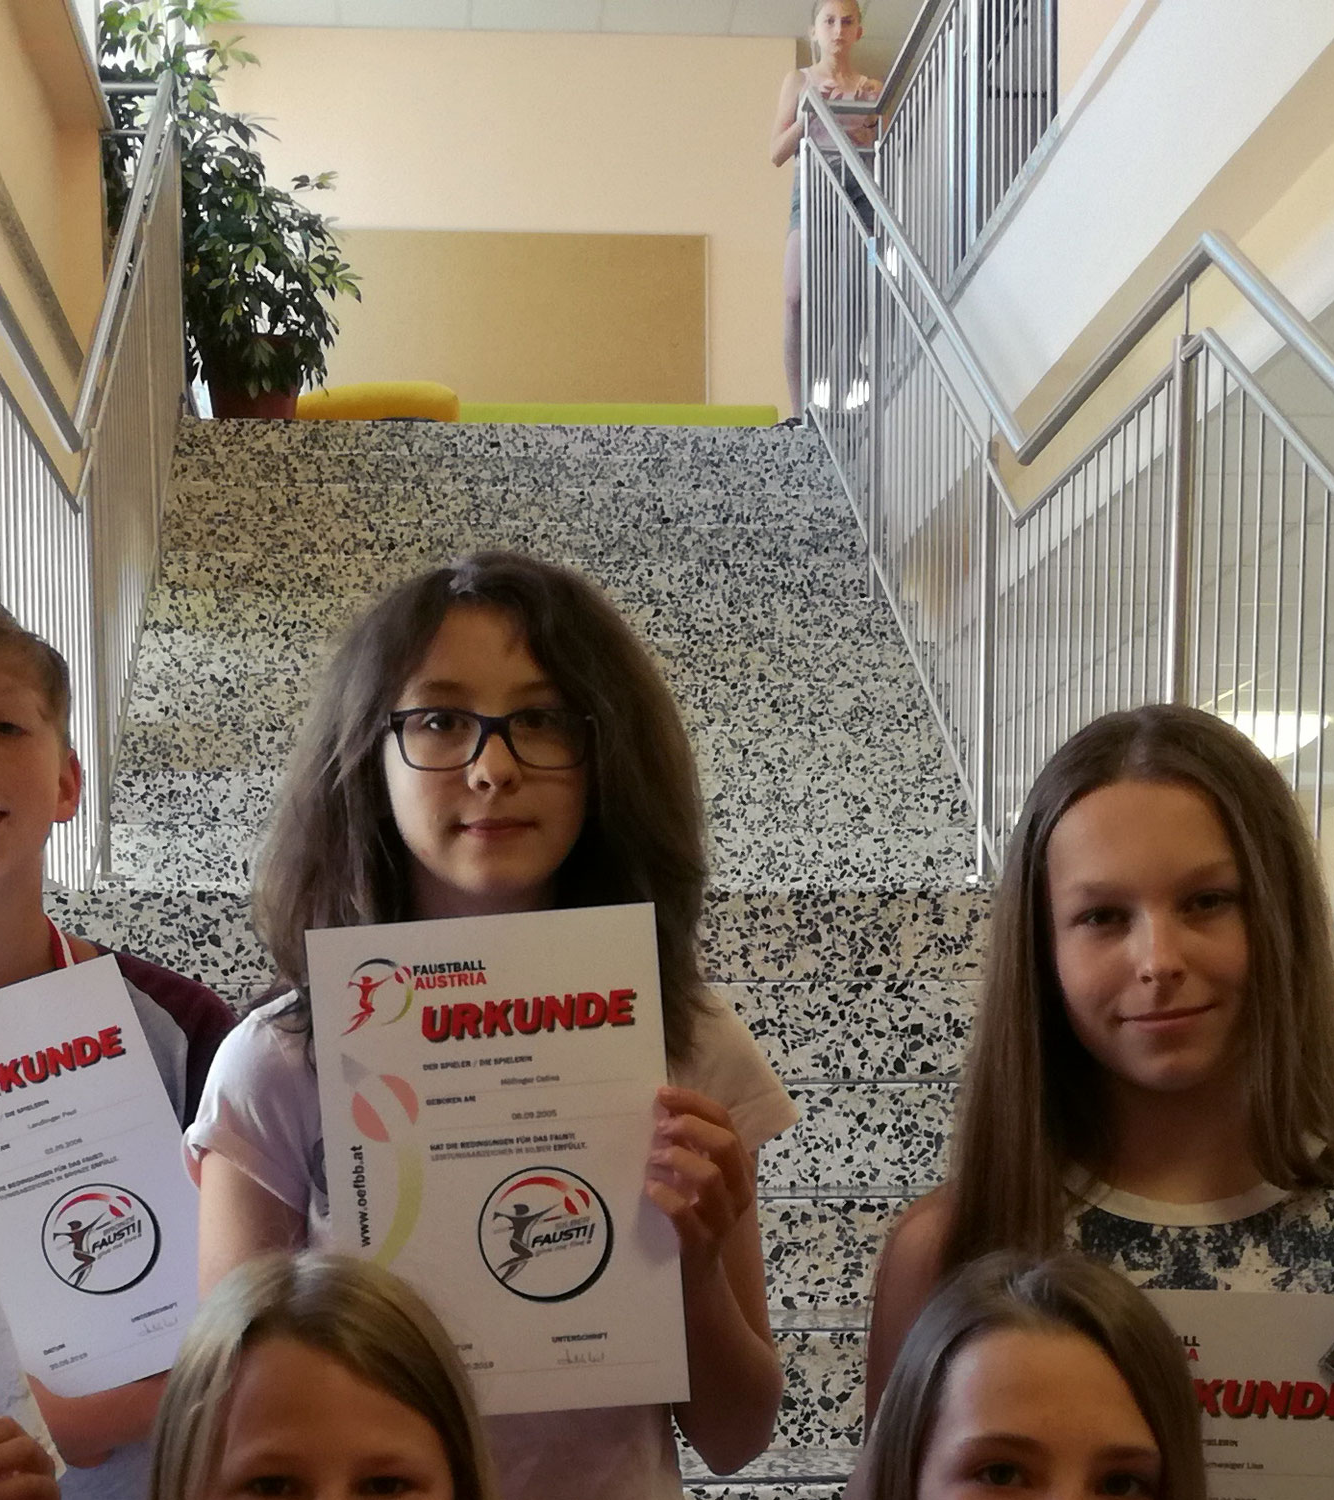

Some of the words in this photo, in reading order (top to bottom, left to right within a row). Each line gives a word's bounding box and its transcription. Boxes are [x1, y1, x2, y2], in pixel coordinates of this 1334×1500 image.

[413, 960, 486, 976] FAUSTBALL
[414, 972, 487, 991] AUSTRIA
[421, 988, 637, 1043] URKUNDE
[349, 1144, 371, 1247] www.oefbb.at
